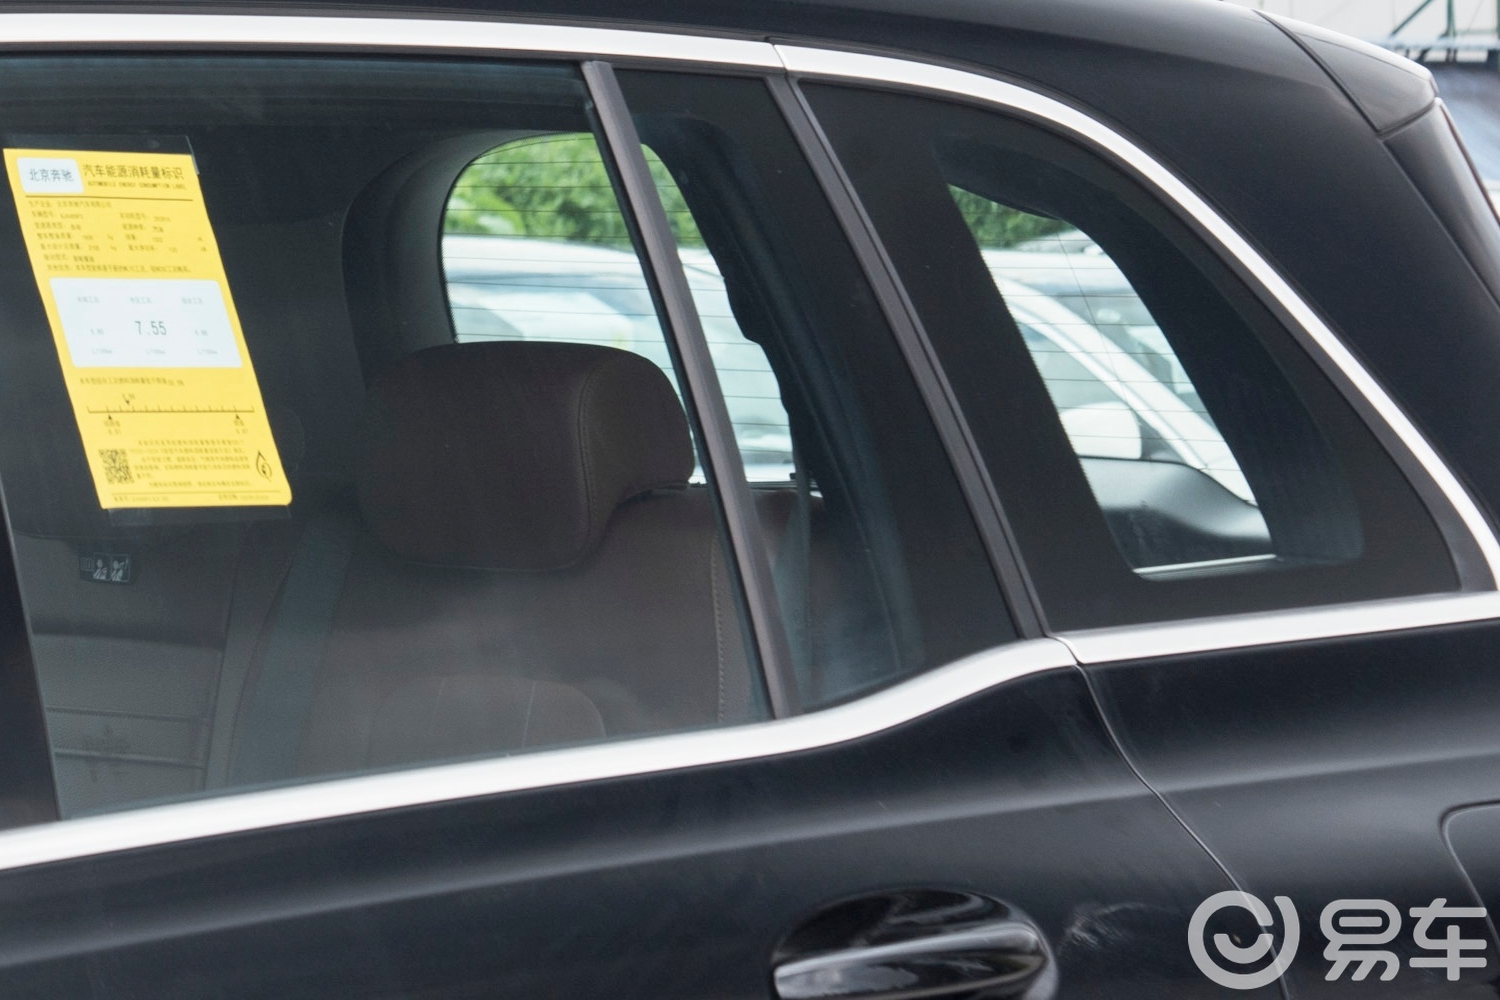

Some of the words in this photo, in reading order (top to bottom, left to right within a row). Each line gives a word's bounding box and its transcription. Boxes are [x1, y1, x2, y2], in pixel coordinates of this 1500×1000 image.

[28, 167, 75, 183] 北京奔驰
[83, 163, 185, 180] 汽车能源消耗量标识
[135, 320, 168, 336] 7.55
